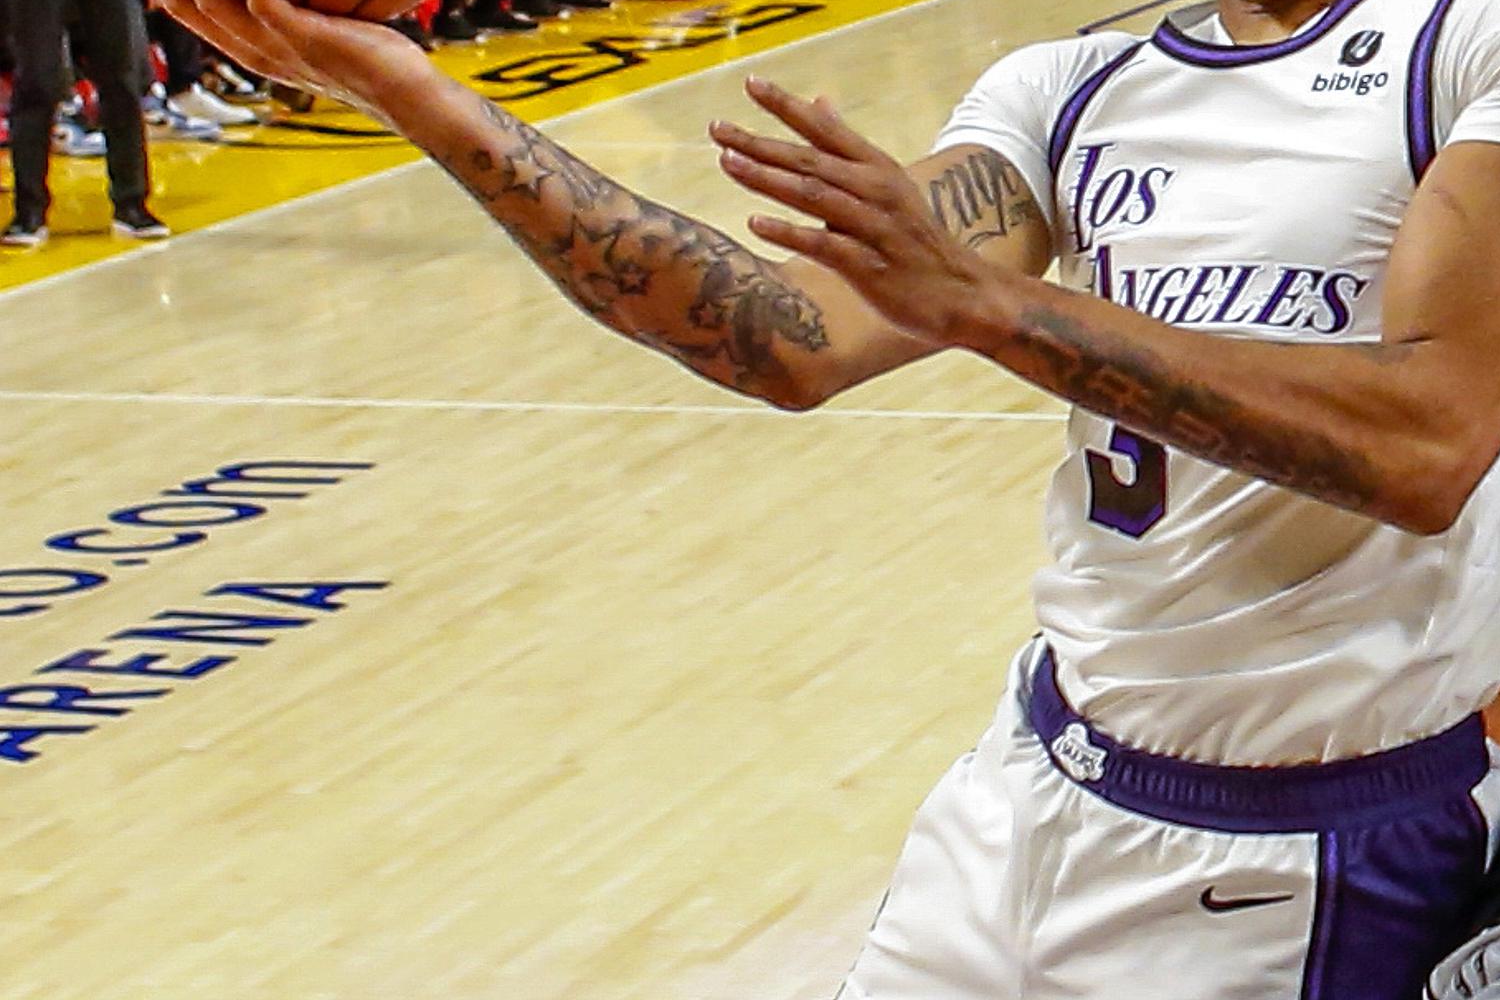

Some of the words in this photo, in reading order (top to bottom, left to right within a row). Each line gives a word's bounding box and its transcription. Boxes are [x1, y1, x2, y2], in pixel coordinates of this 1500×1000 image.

[1311, 71, 1389, 96] bibigo
[1090, 244, 1369, 335] ANGELES
[1083, 421, 1168, 539] 3
[0, 461, 377, 617] o.com
